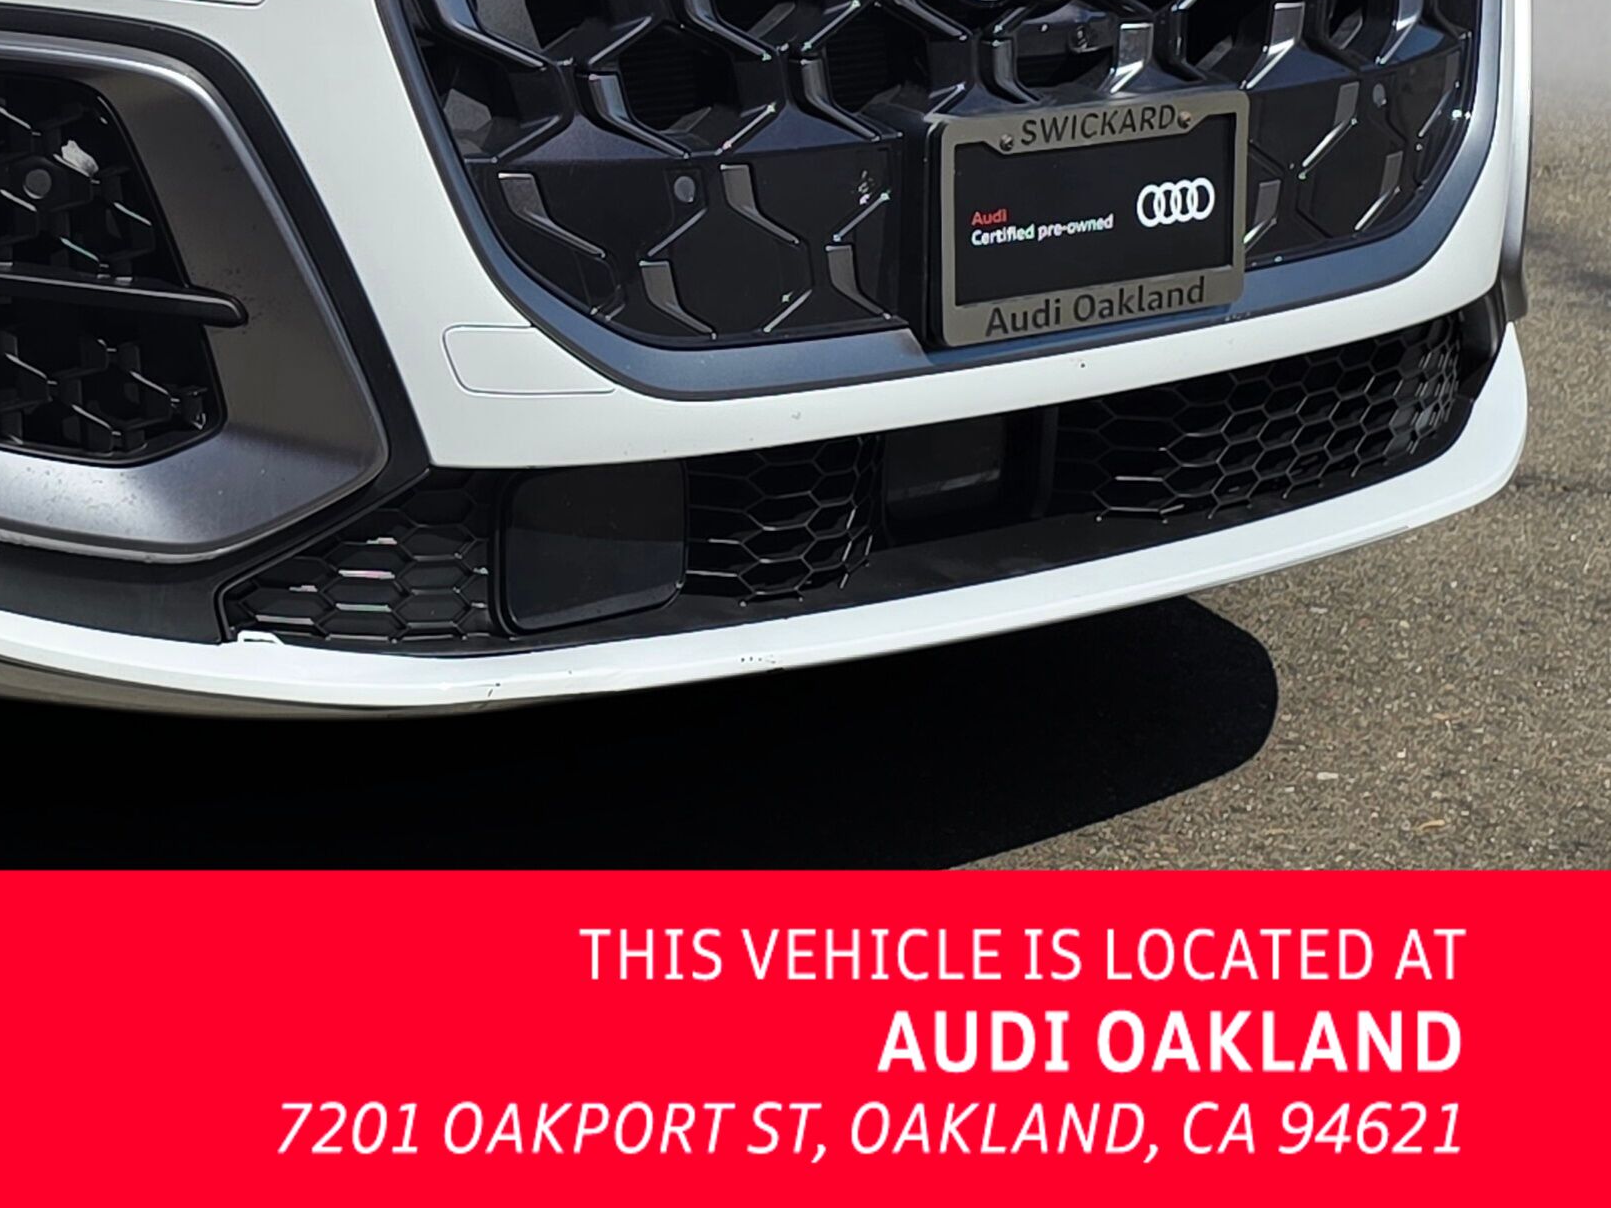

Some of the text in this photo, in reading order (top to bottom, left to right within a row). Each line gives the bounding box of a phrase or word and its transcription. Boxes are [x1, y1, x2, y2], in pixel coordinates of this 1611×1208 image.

[1021, 104, 1176, 145] SWICKARD
[971, 209, 1007, 225] Audi
[971, 213, 1114, 246] Certified pre-owned
[986, 275, 1205, 337] Audi Oakland
